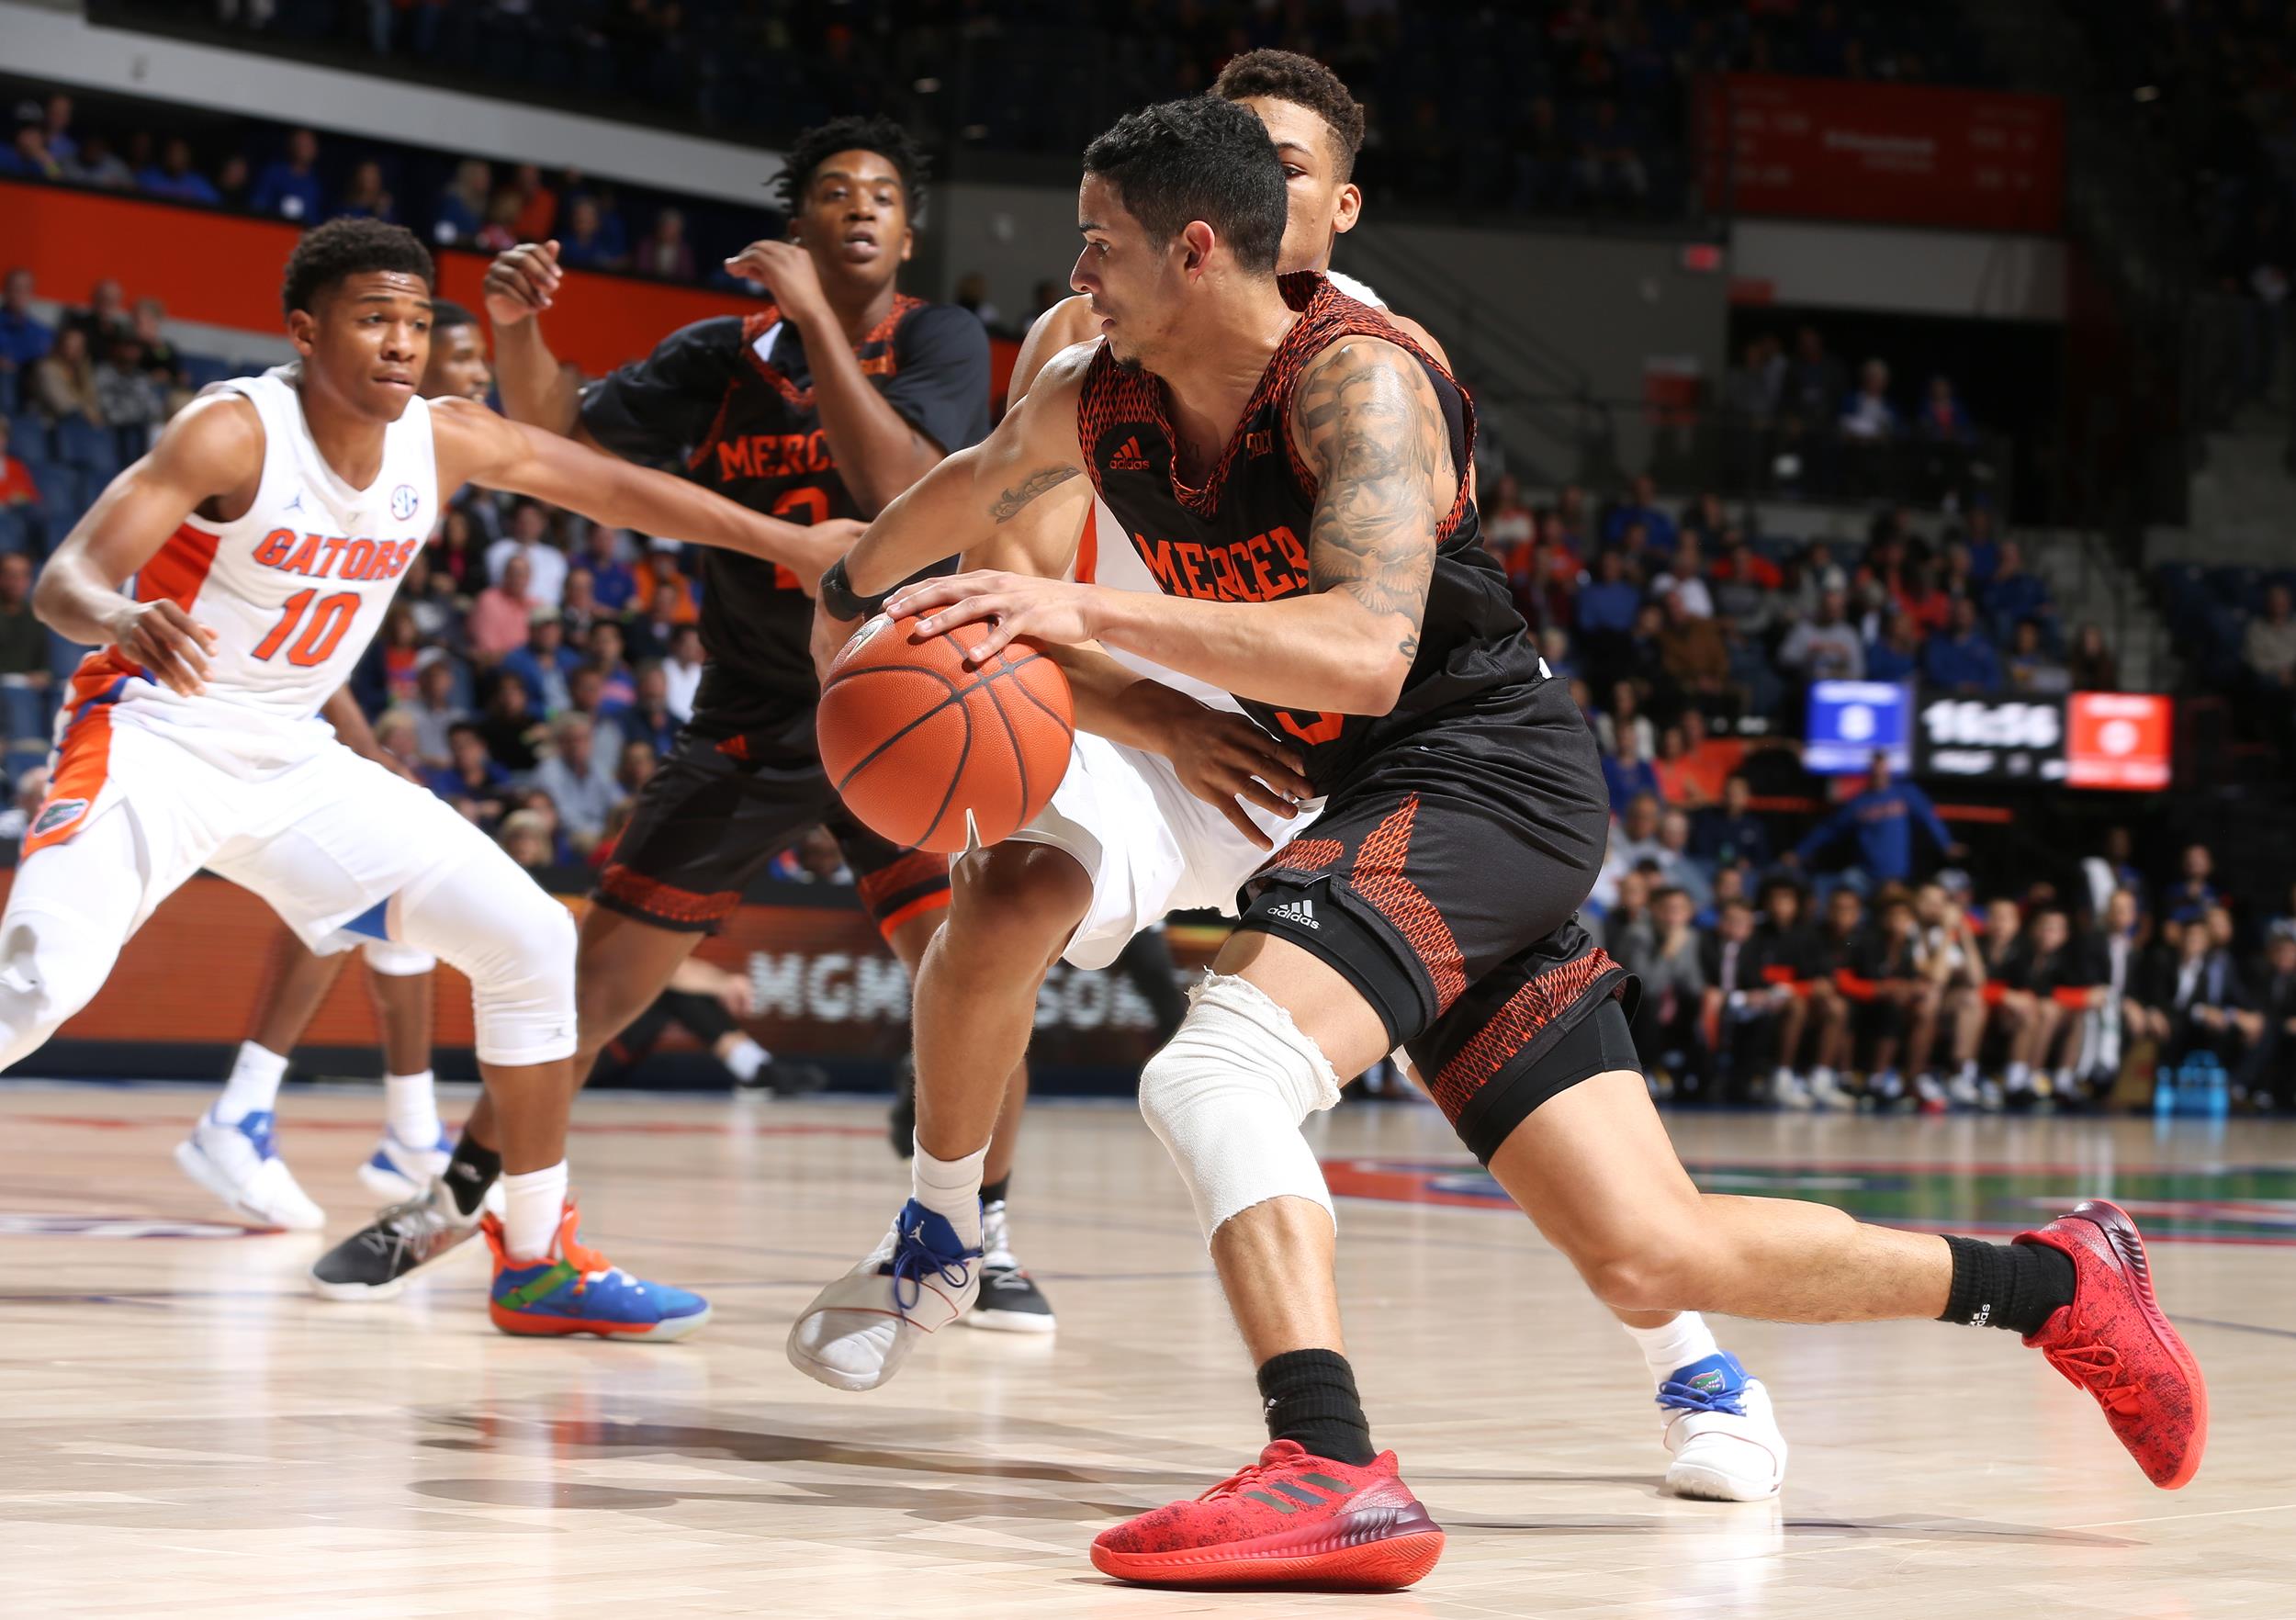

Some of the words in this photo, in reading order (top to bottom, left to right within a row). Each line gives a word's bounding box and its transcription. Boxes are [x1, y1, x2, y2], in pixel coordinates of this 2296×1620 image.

[717, 430, 838, 482] MERC
[1109, 457, 1151, 470] adidas
[1246, 429, 1274, 460] SOC
[252, 527, 417, 581] GATORS
[1134, 525, 1309, 603] MERCER
[251, 588, 362, 667] 10
[1266, 906, 1321, 930] adidas
